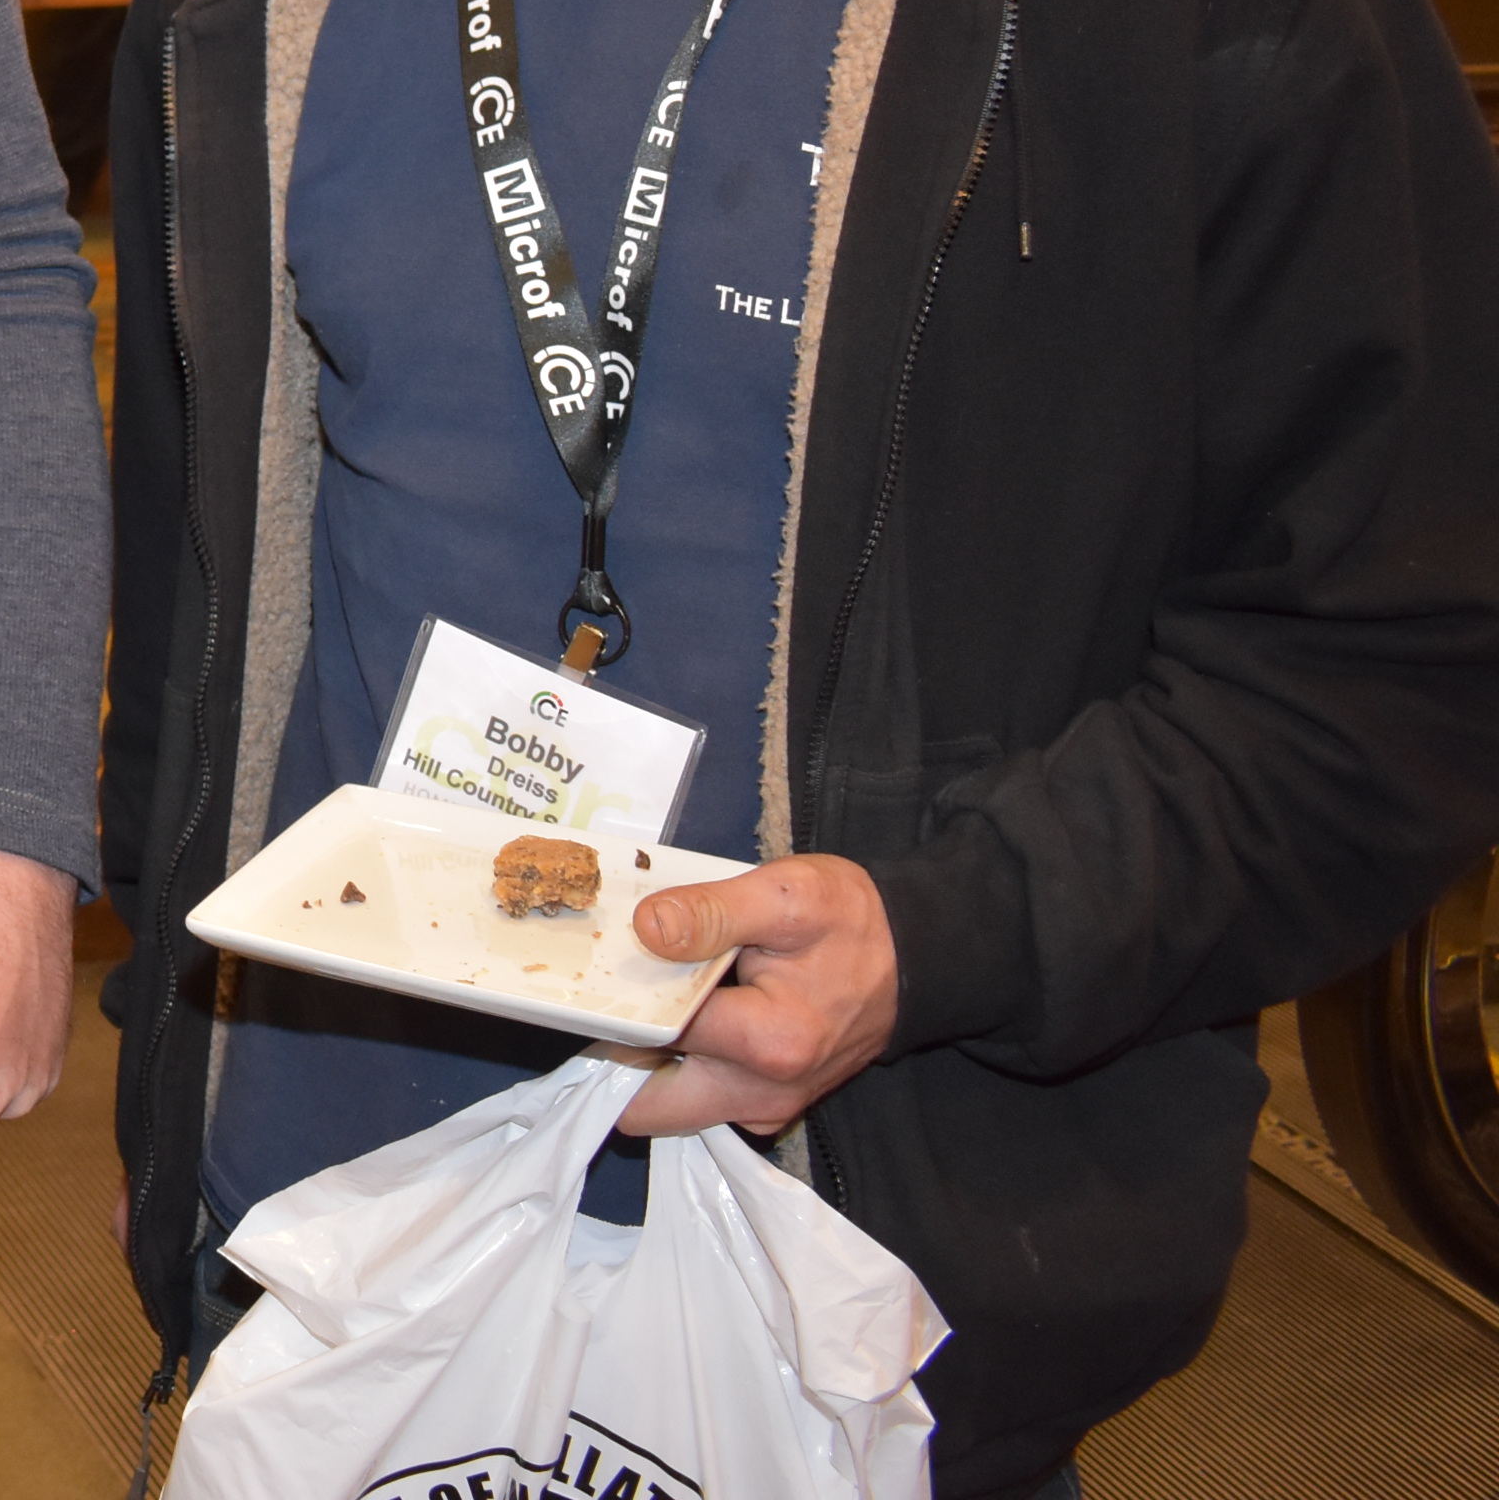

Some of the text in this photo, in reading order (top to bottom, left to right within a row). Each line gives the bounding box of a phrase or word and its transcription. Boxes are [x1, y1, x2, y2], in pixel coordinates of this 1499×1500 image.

[802, 142, 823, 186] T
[483, 159, 565, 319] Microf
[606, 167, 668, 332] Microf
[715, 284, 805, 326] THE L
[403, 748, 442, 780] Hill
[484, 716, 585, 785] Bobby
[487, 755, 559, 805] Dreiss
